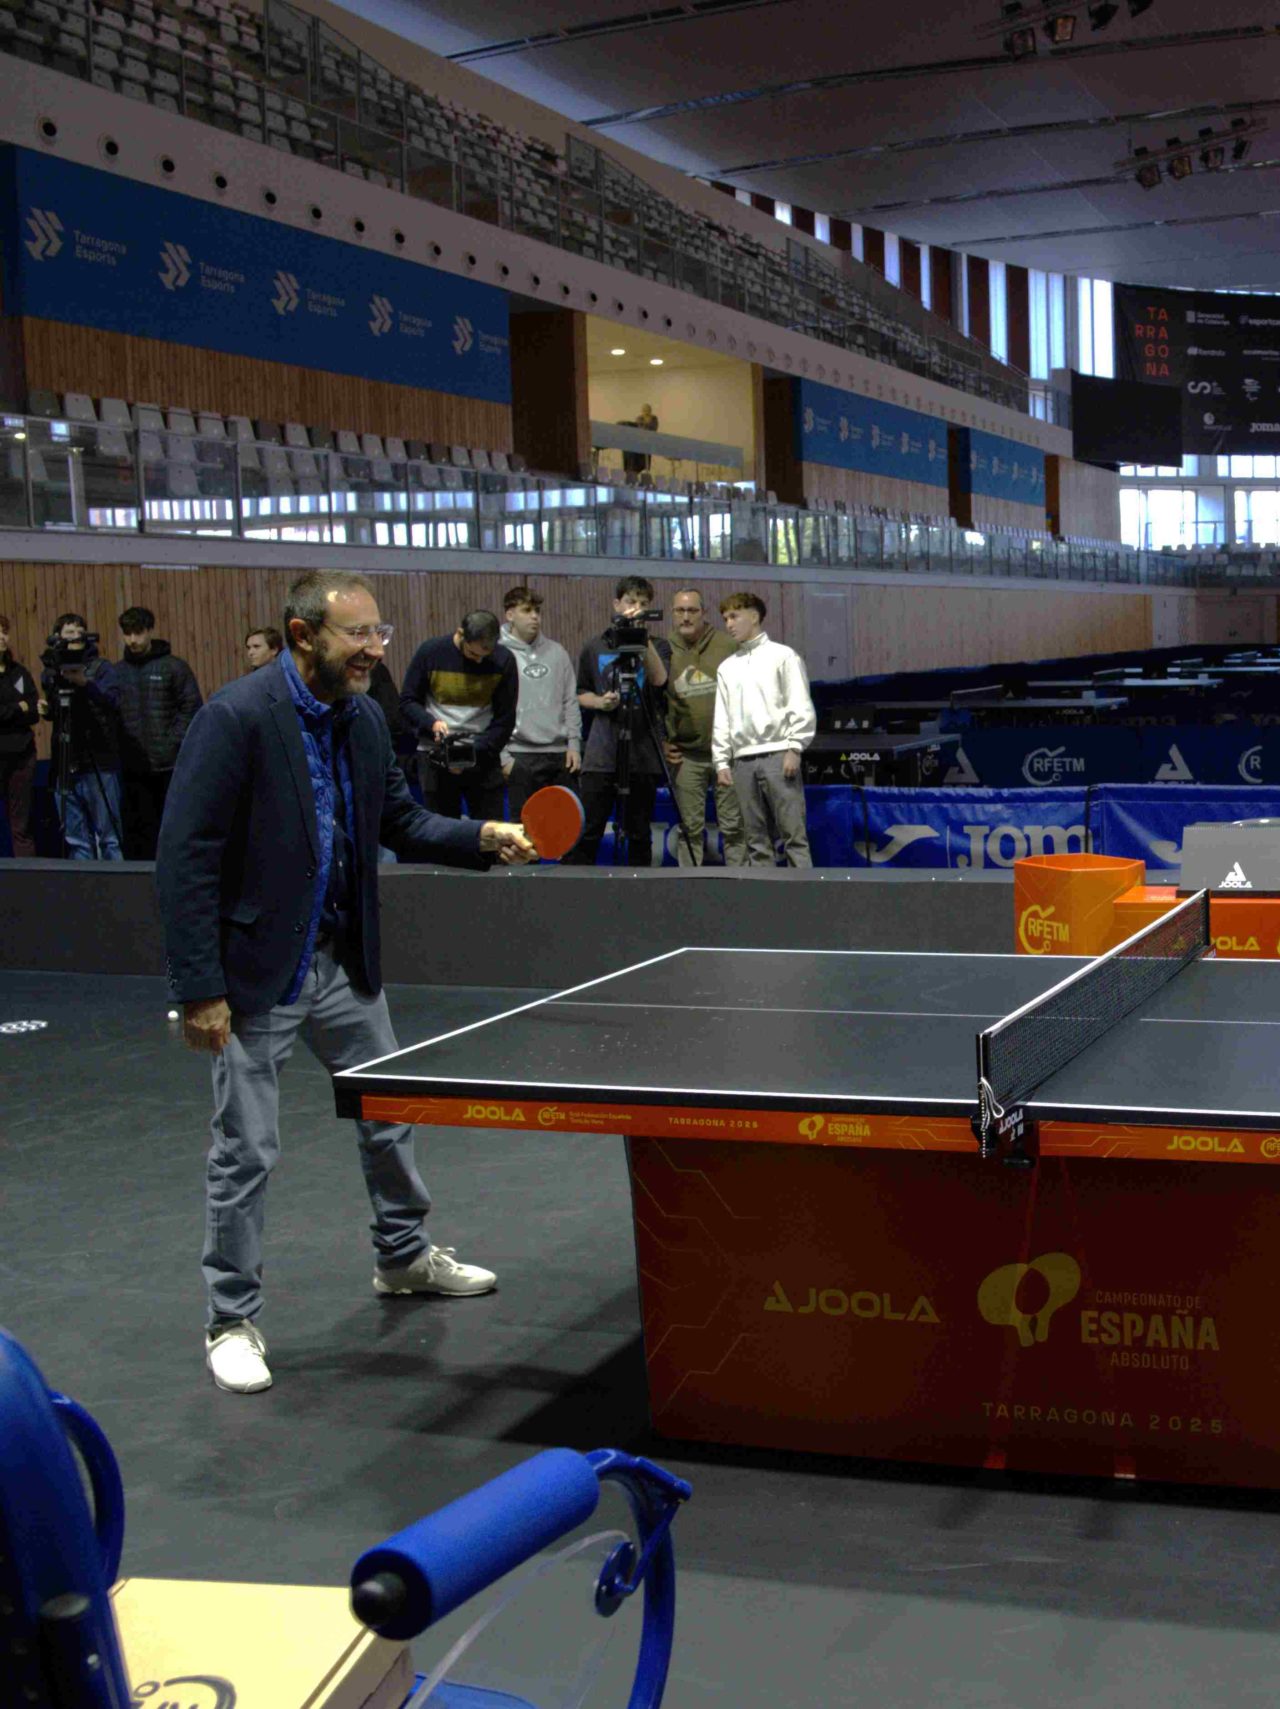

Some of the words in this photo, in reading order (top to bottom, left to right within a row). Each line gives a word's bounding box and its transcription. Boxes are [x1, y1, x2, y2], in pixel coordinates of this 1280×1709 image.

[73, 230, 127, 255] Tarragona
[74, 245, 117, 266] Esports
[199, 262, 246, 283] Tarragona
[199, 276, 236, 294] Esports
[1147, 306, 1169, 321] TA
[1135, 323, 1169, 340] RRA
[1145, 343, 1169, 358] GO
[1144, 361, 1170, 377] NA
[848, 752, 881, 761] JOOLA
[1032, 758, 1086, 772] RFETM
[957, 824, 1094, 869] Jom
[1218, 880, 1253, 889] JOOLA
[1027, 917, 1070, 944] RFETM
[1210, 936, 1261, 951] OLA
[462, 1104, 527, 1122] JOOLA
[668, 1116, 726, 1127] TARRAGONA
[827, 1121, 871, 1138] ESPAÑA
[1166, 1135, 1246, 1154] JOOLA
[798, 1286, 941, 1324] JOOLA
[1095, 1290, 1181, 1308] CAMPEONATO
[1184, 1296, 1202, 1310] DE
[1080, 1309, 1220, 1351] ESPAÑA
[1110, 1351, 1190, 1371] ABSOLUTO
[981, 1402, 1134, 1429] TARRAGONA
[1149, 1413, 1224, 1435] 2025
